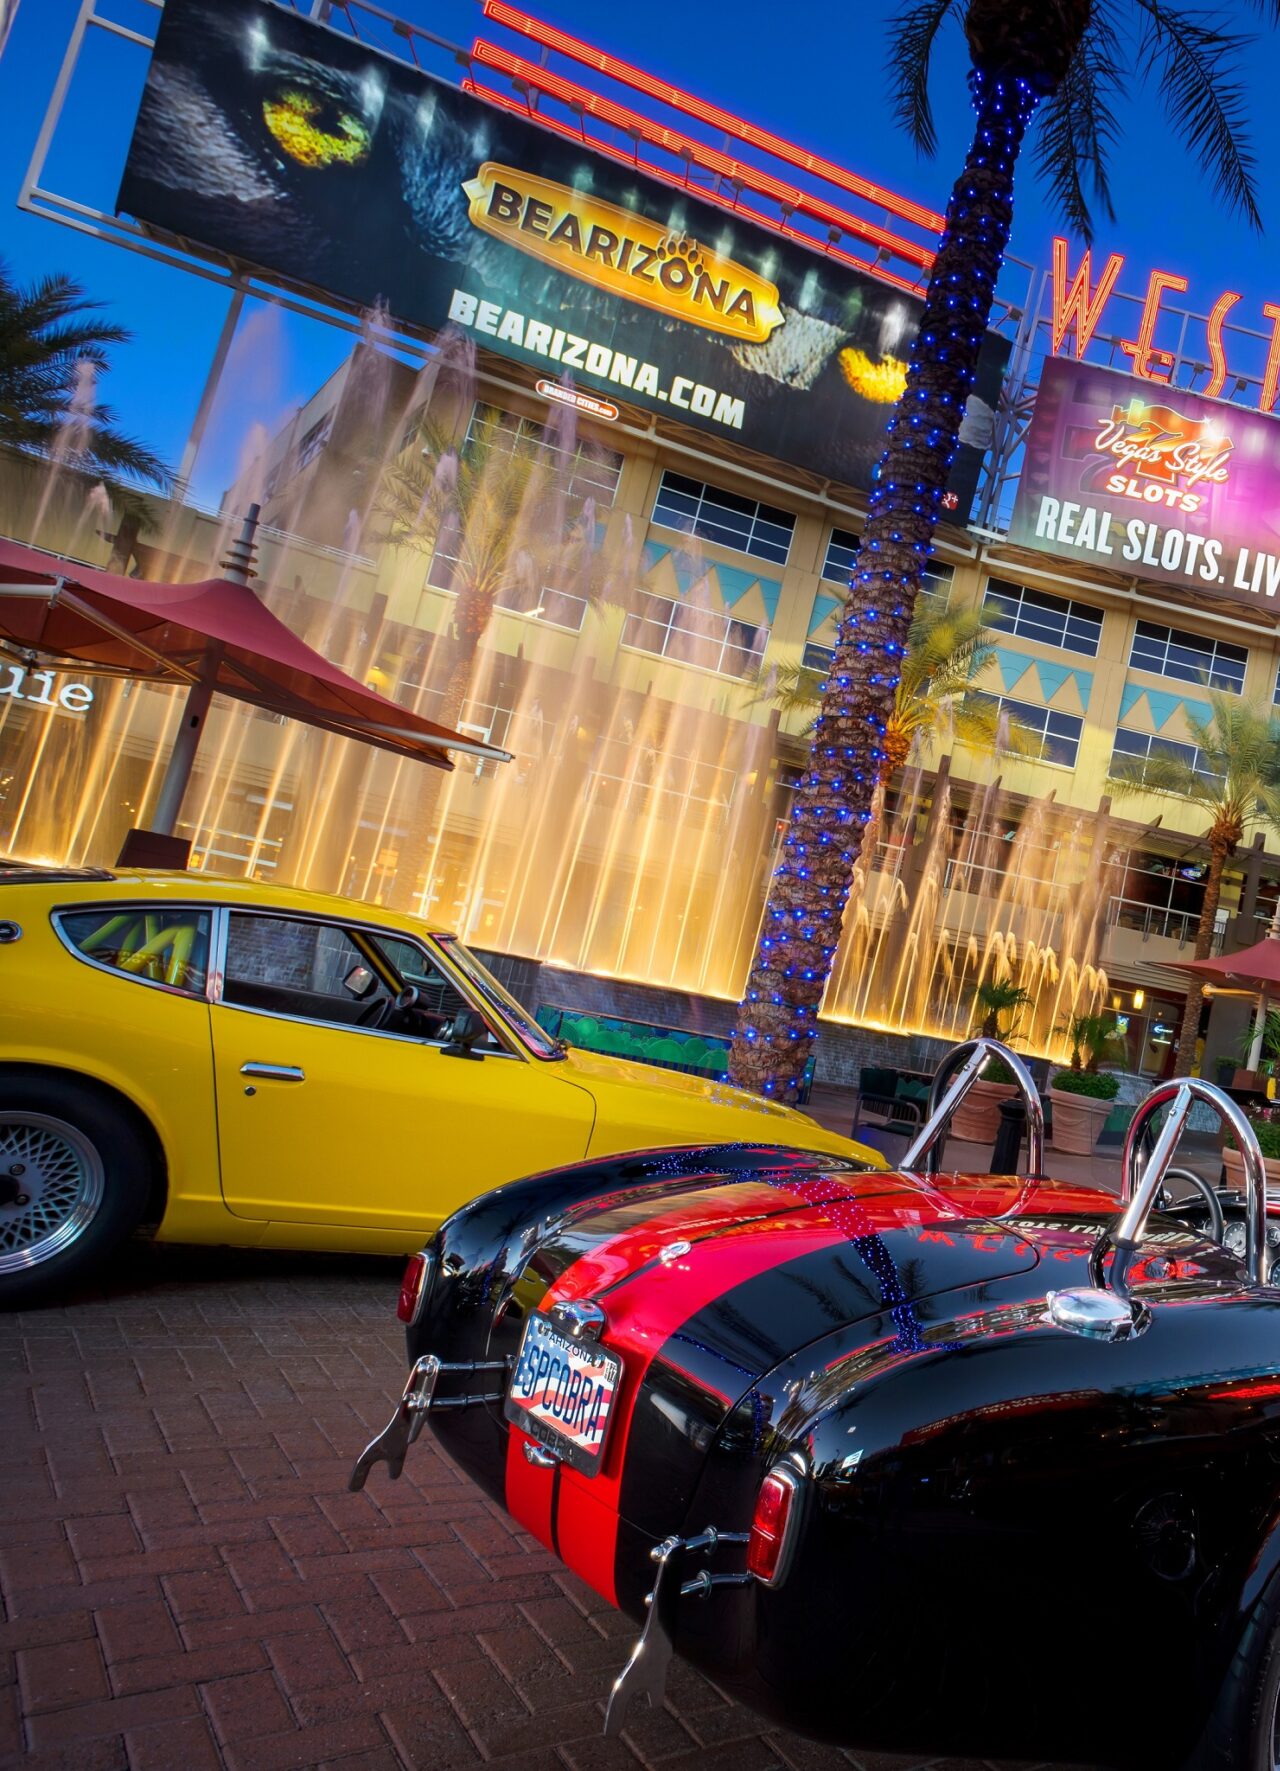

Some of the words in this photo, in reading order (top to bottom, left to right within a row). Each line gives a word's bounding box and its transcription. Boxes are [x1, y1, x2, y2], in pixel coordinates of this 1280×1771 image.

[485, 181, 758, 328] BEARIZONA
[448, 288, 746, 430] BEARIZONA.COM
[1095, 419, 1162, 468] Vegas
[1165, 442, 1230, 486] Style
[1106, 475, 1201, 512] SLOTS
[1035, 496, 1113, 556] REAL
[1122, 518, 1224, 584] SLOTS.
[549, 1334, 592, 1363] ARIZONA
[521, 1344, 605, 1442] SPCOBRA
